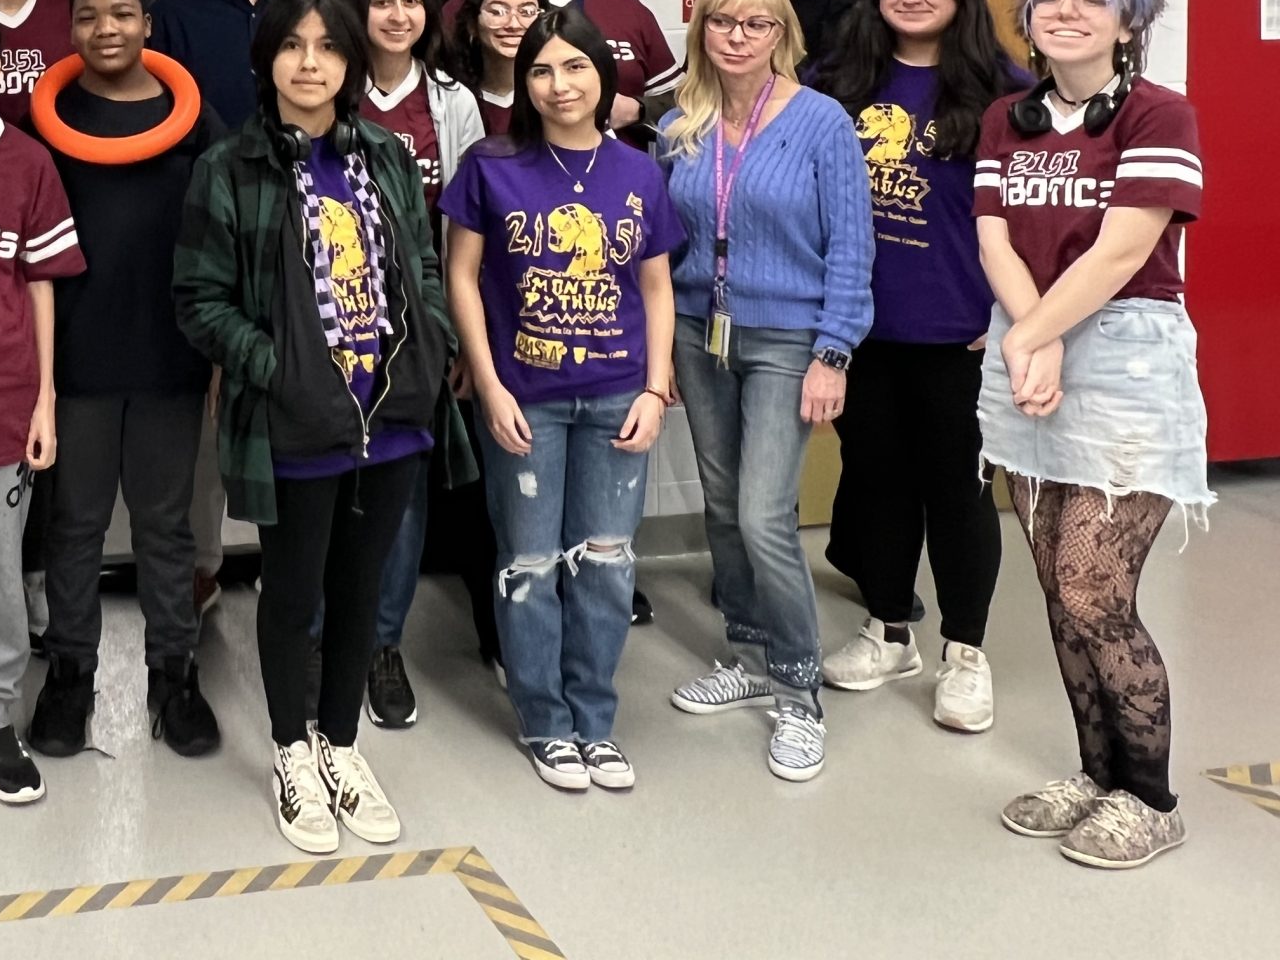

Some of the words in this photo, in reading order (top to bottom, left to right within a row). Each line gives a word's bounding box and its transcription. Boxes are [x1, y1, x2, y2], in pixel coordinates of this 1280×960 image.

[1000, 176, 1115, 209] BOTICS
[532, 277, 608, 297] MONTY
[525, 291, 617, 312] PYTHONS
